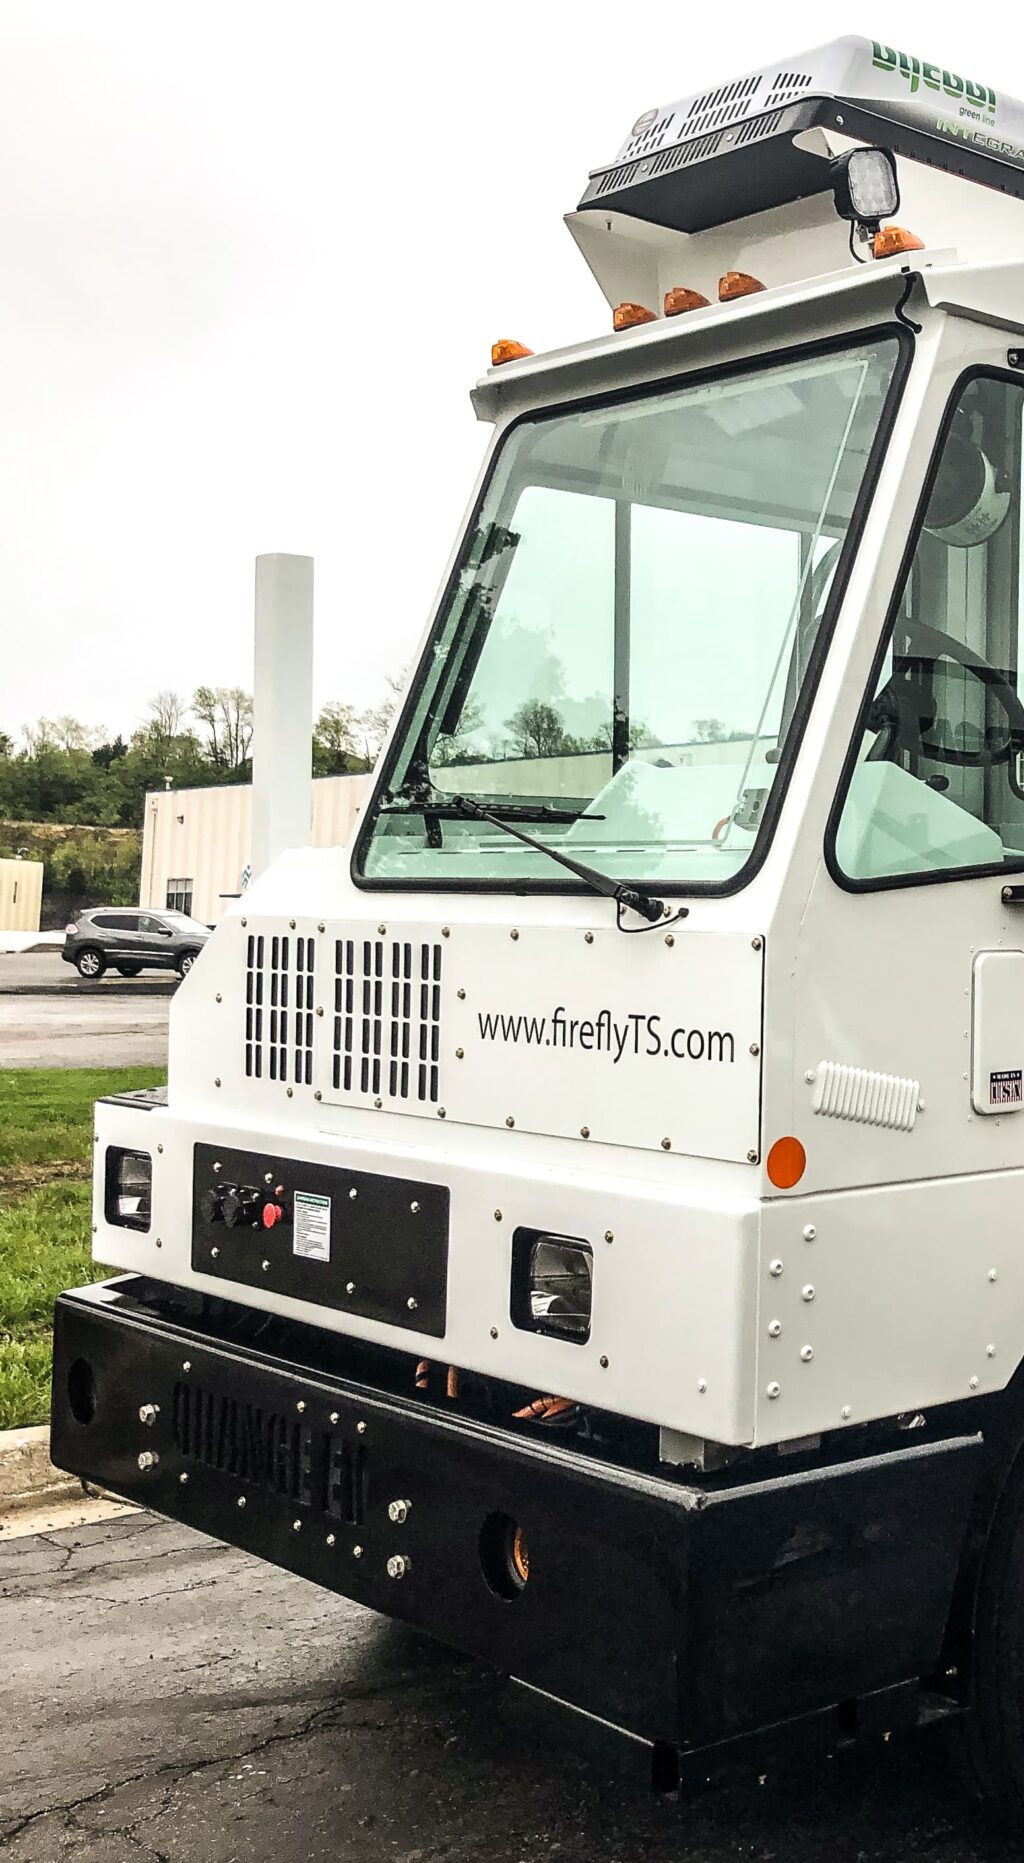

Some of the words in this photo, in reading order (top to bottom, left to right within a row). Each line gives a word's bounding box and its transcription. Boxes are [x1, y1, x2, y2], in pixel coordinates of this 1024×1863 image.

[959, 106, 981, 120] green
[981, 114, 996, 127] line
[478, 1006, 735, 1064] www.fireflyTS.com
[992, 1084, 1020, 1099] USA
